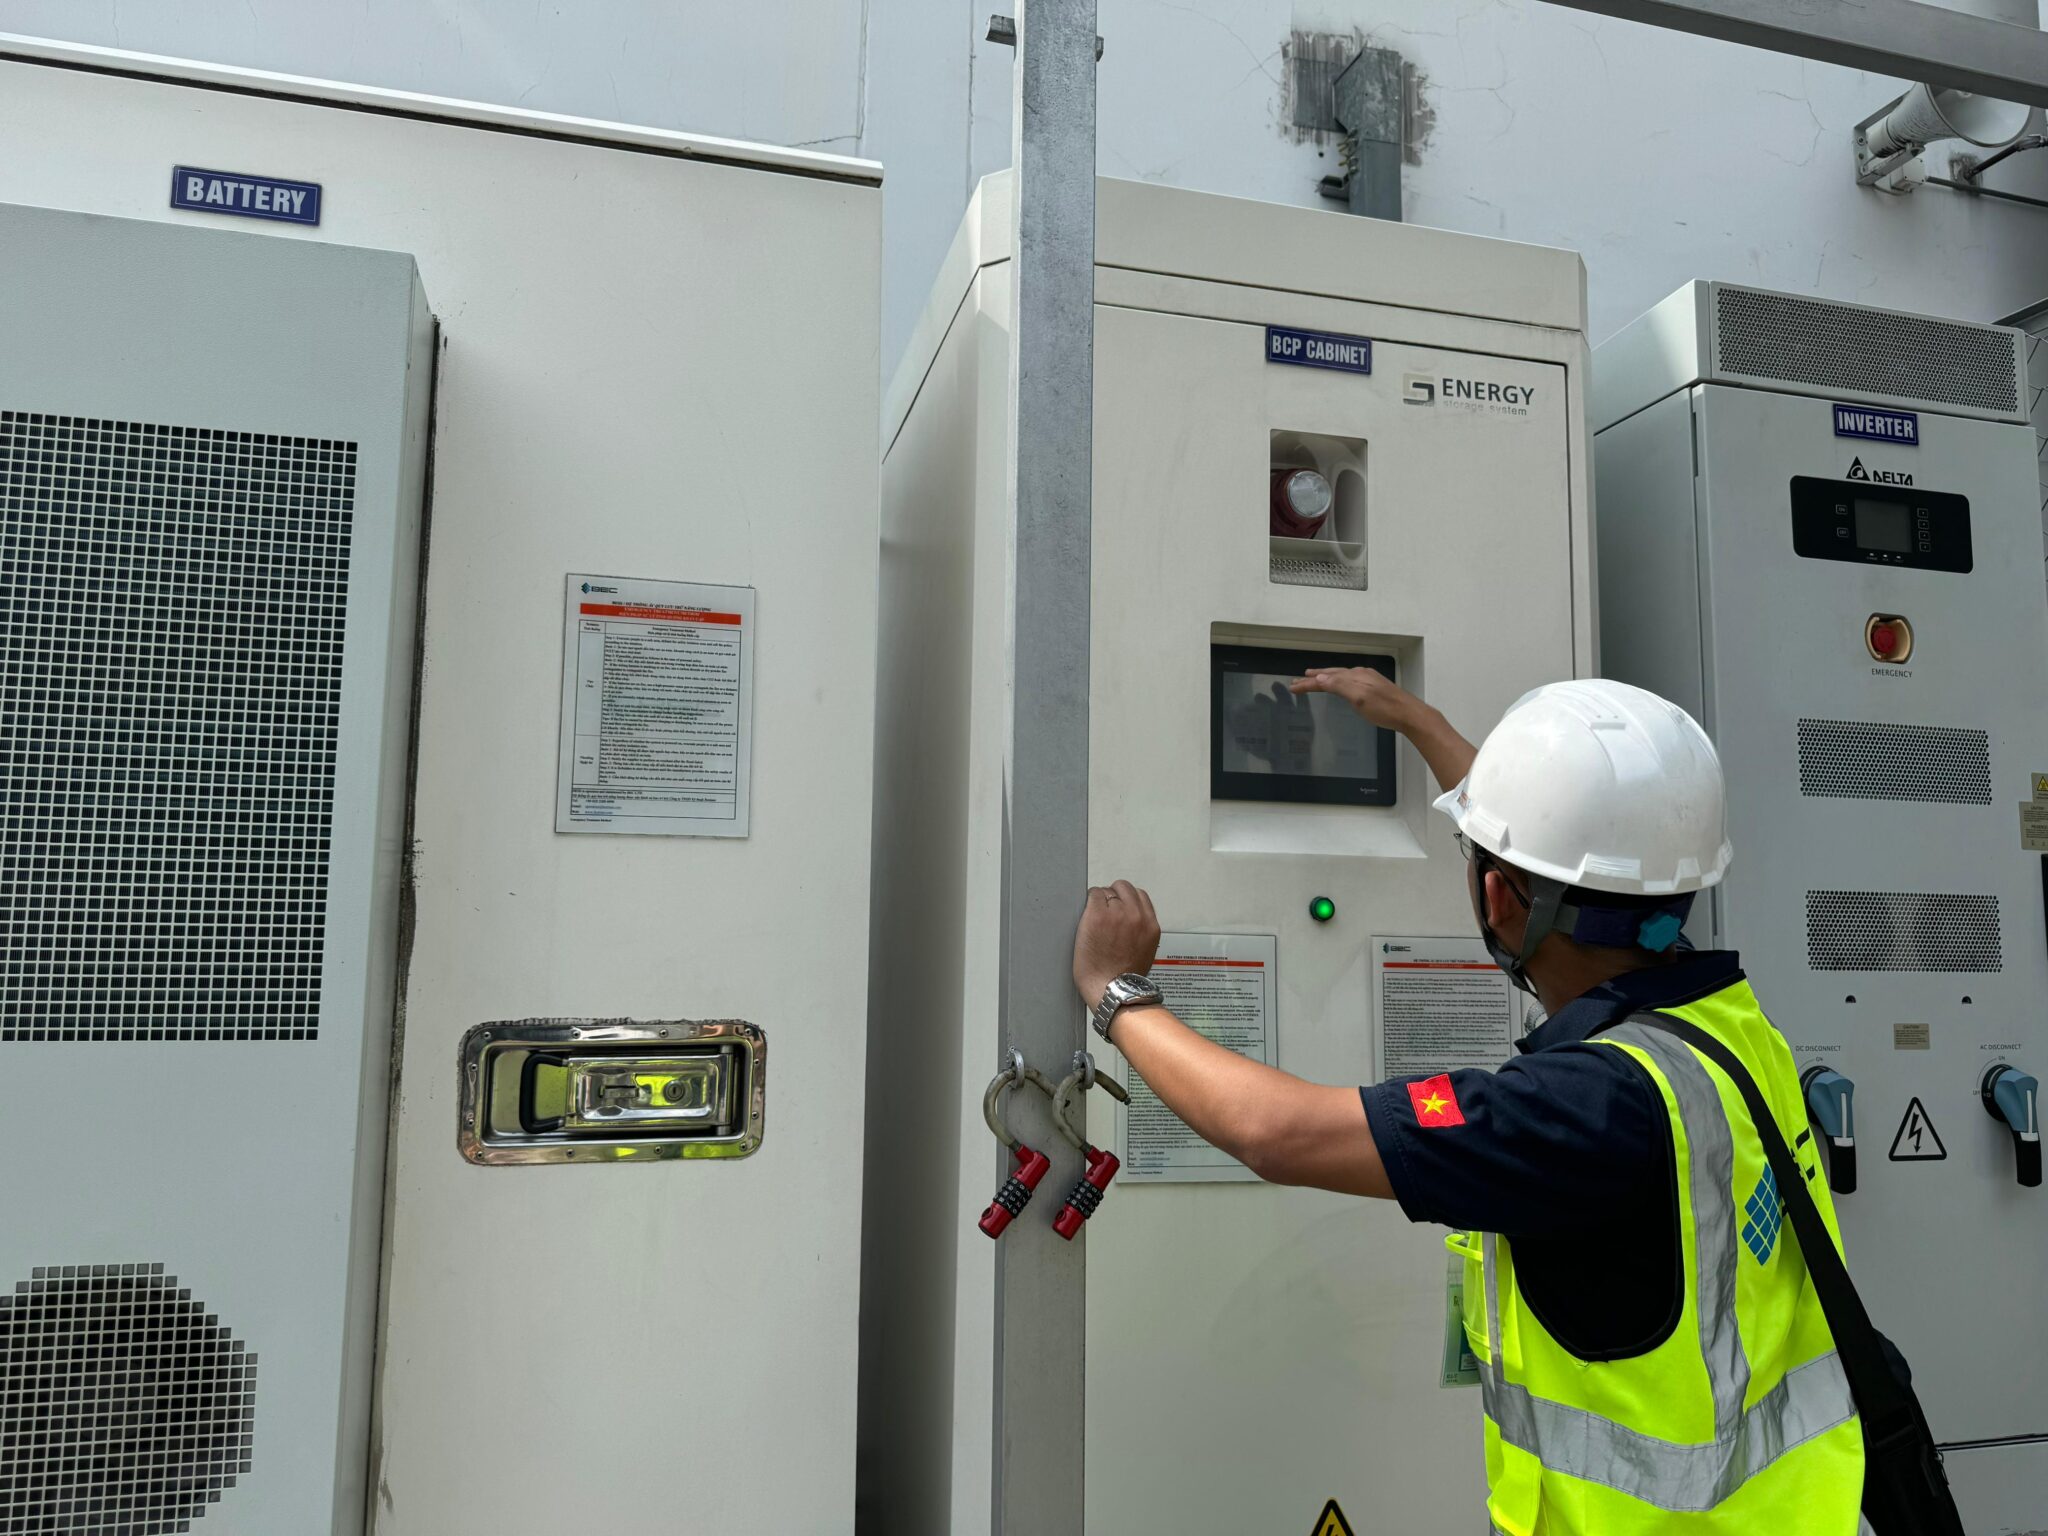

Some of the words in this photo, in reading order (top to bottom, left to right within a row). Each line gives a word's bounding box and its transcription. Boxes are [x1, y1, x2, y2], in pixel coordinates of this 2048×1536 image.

[186, 176, 307, 215] BATTERY
[1272, 335, 1302, 356] BCP
[1306, 340, 1367, 366] CABINET
[1442, 378, 1535, 406] ENERGY
[1443, 399, 1484, 413] storage
[1490, 405, 1528, 416] system
[1838, 411, 1915, 439] INVERTER
[1873, 470, 1913, 486] DELTA
[1871, 667, 1913, 678] EMERGENCY
[1989, 1043, 2022, 1051] DISCONNECT
